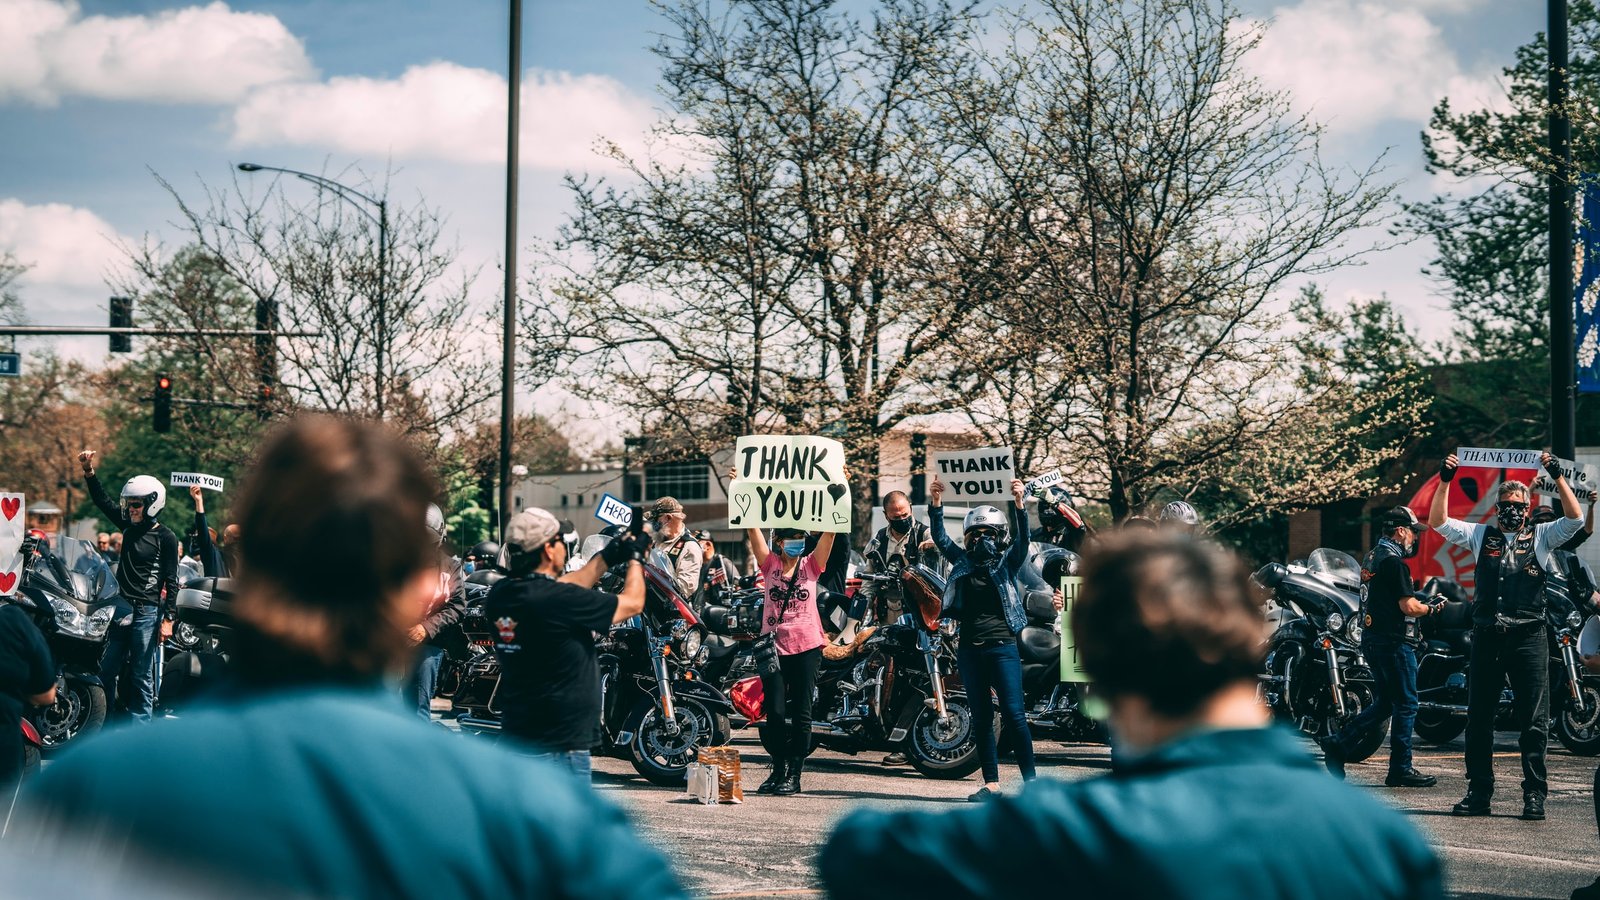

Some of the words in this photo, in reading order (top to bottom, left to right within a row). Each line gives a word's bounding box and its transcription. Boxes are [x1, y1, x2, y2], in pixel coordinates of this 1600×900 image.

[741, 444, 831, 482] THANK
[938, 455, 1011, 473] THANK
[1463, 450, 1505, 463] THANK
[1507, 452, 1537, 464] YOU!
[172, 474, 201, 484] THANK
[202, 477, 222, 488] YOU!
[950, 479, 1003, 495] YOU!
[1038, 472, 1061, 485] YOU!
[756, 485, 823, 522] YOU!!
[603, 501, 632, 524] HERO
